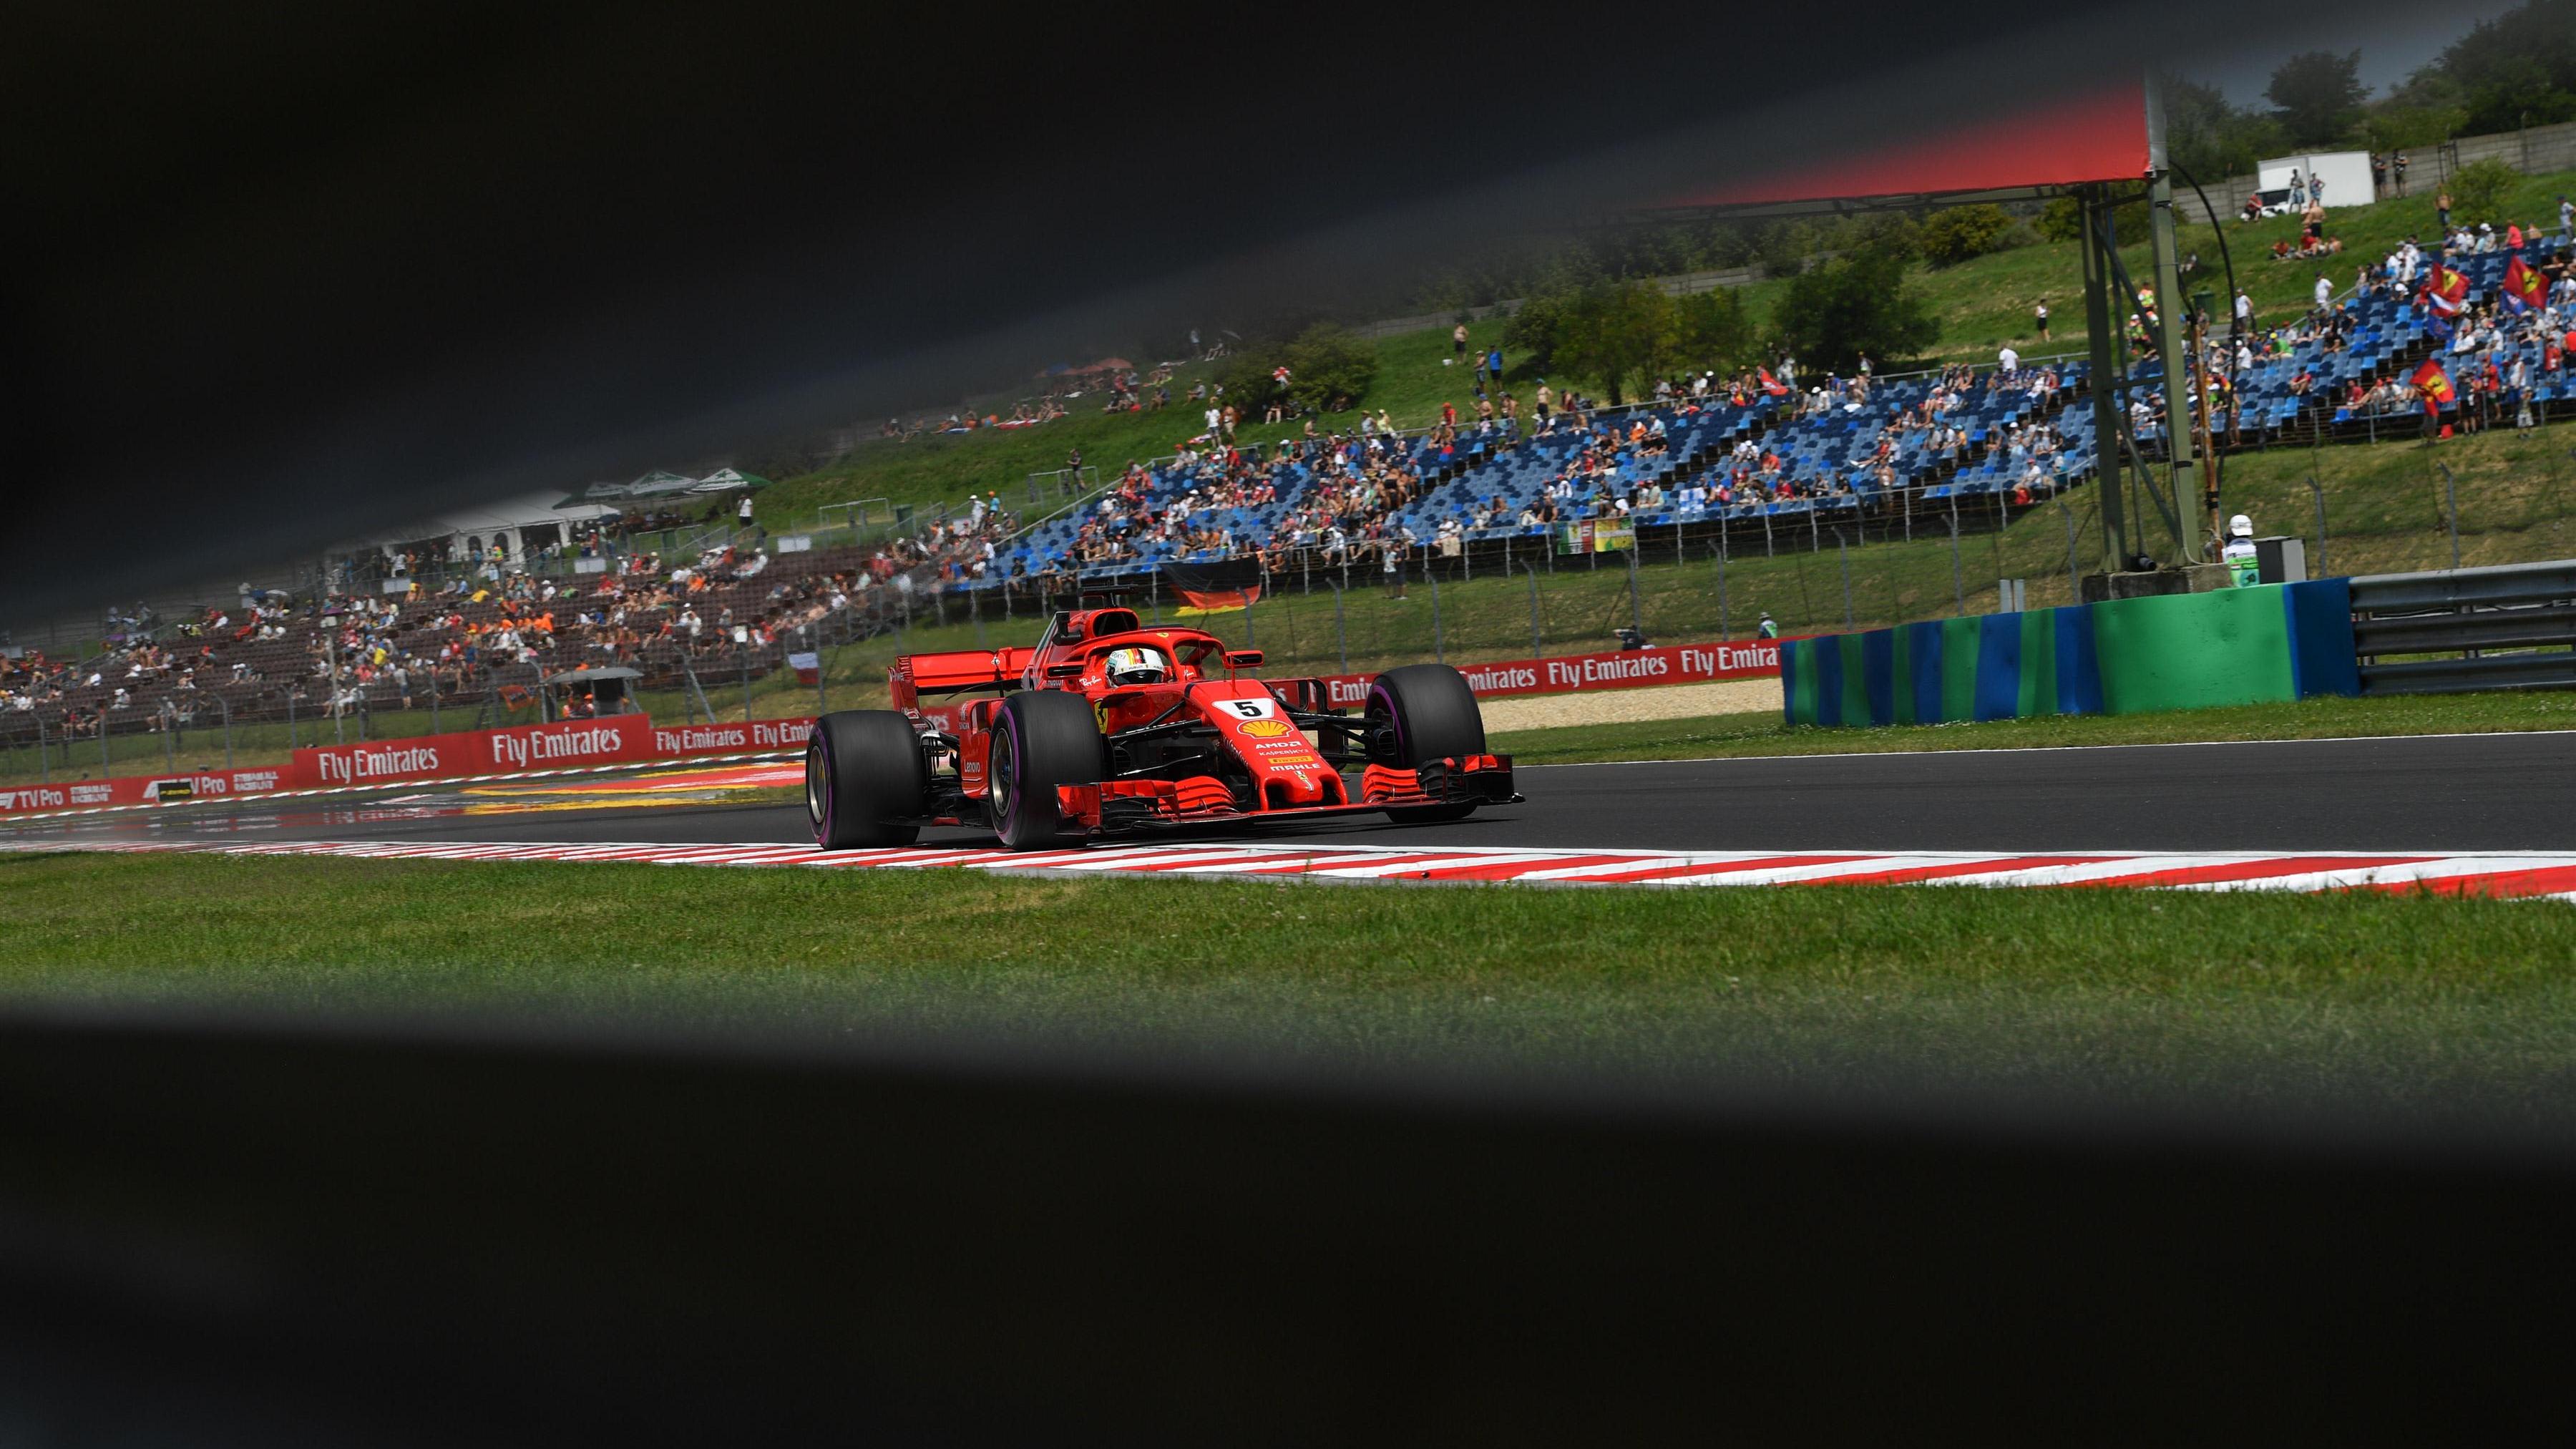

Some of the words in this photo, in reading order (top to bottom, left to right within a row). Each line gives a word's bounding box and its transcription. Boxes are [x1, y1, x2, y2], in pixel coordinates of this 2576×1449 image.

[1547, 662, 1580, 687] Fly
[1583, 655, 1668, 681] Emirates
[1681, 650, 1714, 675] Fly
[1717, 643, 1780, 670] Emira
[1459, 667, 1536, 691] mirates
[1234, 701, 1262, 717] 5
[492, 734, 527, 767] Fly
[531, 727, 622, 759] Emirates
[655, 731, 680, 754] Fly
[682, 728, 746, 750] Emirates
[753, 724, 778, 747] Fly
[318, 753, 351, 784] Fly
[354, 746, 439, 777] Emirates
[964, 761, 980, 773] Lenovo
[201, 776, 226, 794] Pro
[18, 790, 38, 808] TV
[40, 789, 64, 806] Pro
